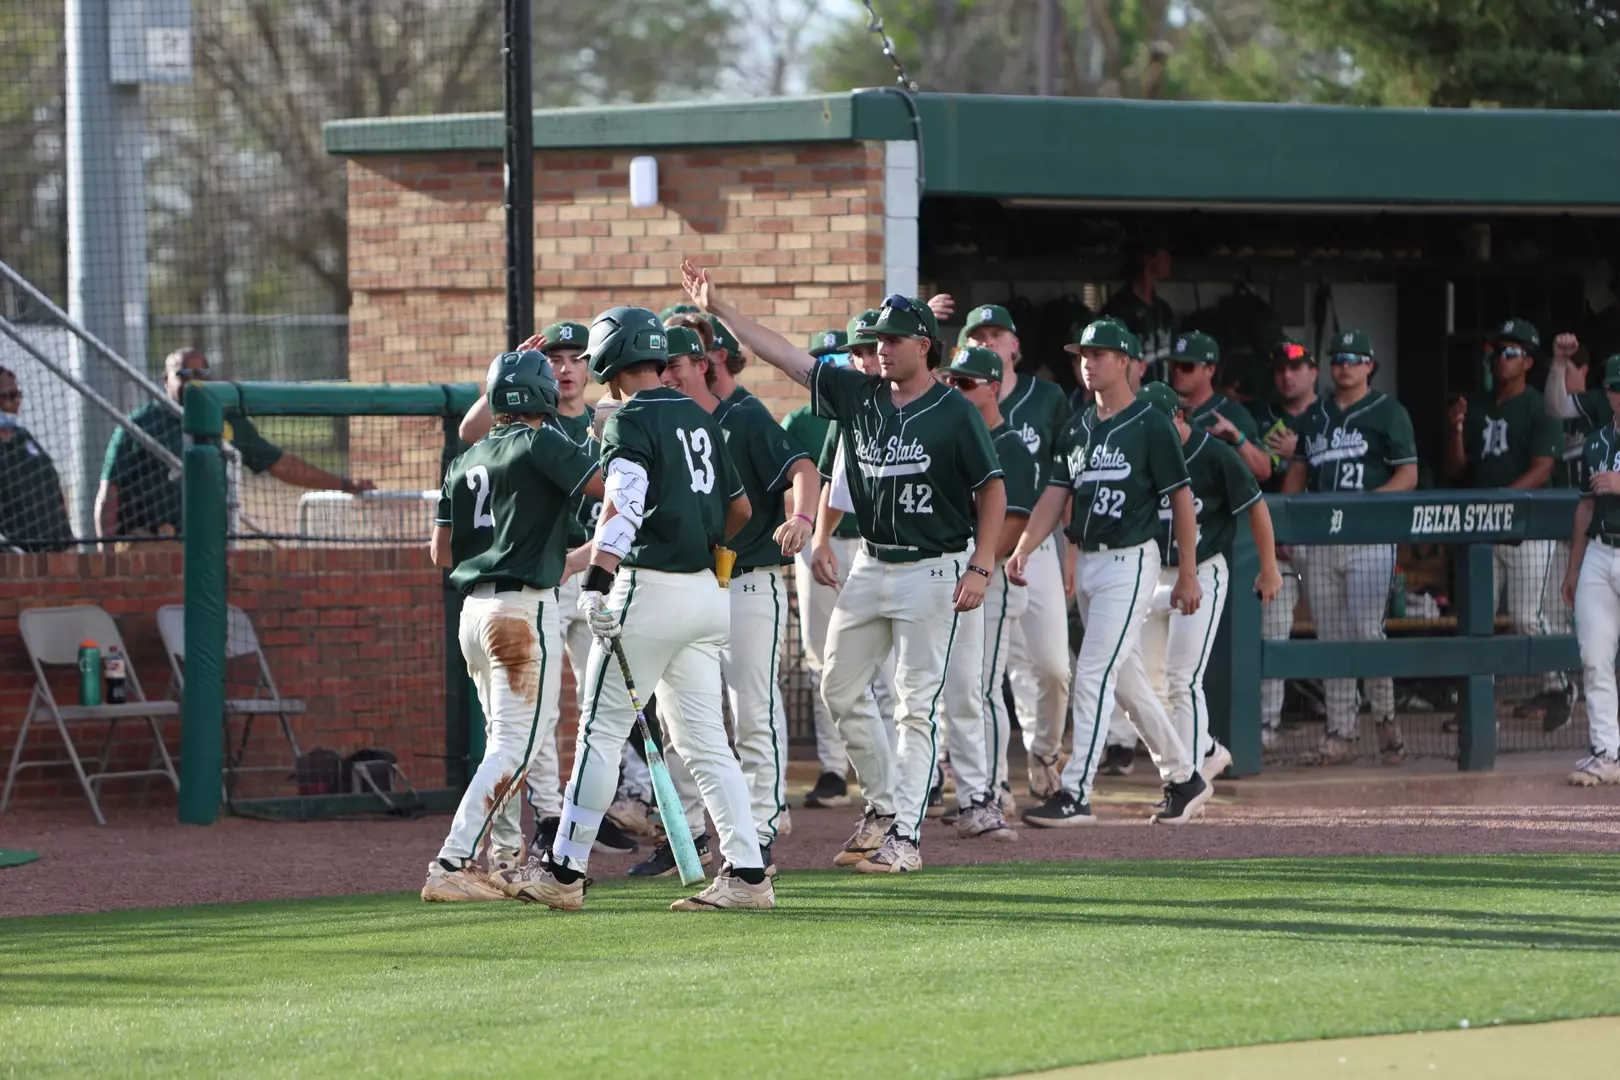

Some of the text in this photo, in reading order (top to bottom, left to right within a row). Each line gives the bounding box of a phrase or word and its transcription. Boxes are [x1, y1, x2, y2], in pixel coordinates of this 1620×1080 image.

[559, 325, 573, 341] D
[854, 429, 924, 463] Delta State
[1331, 426, 1363, 450] State
[676, 427, 716, 495] 13
[1090, 444, 1125, 468] State
[1340, 462, 1365, 490] 21
[466, 465, 496, 529] 2
[898, 483, 933, 514] 42
[1093, 487, 1126, 519] 32
[1329, 508, 1343, 535] D
[1411, 503, 1514, 534] DELTA STATE
